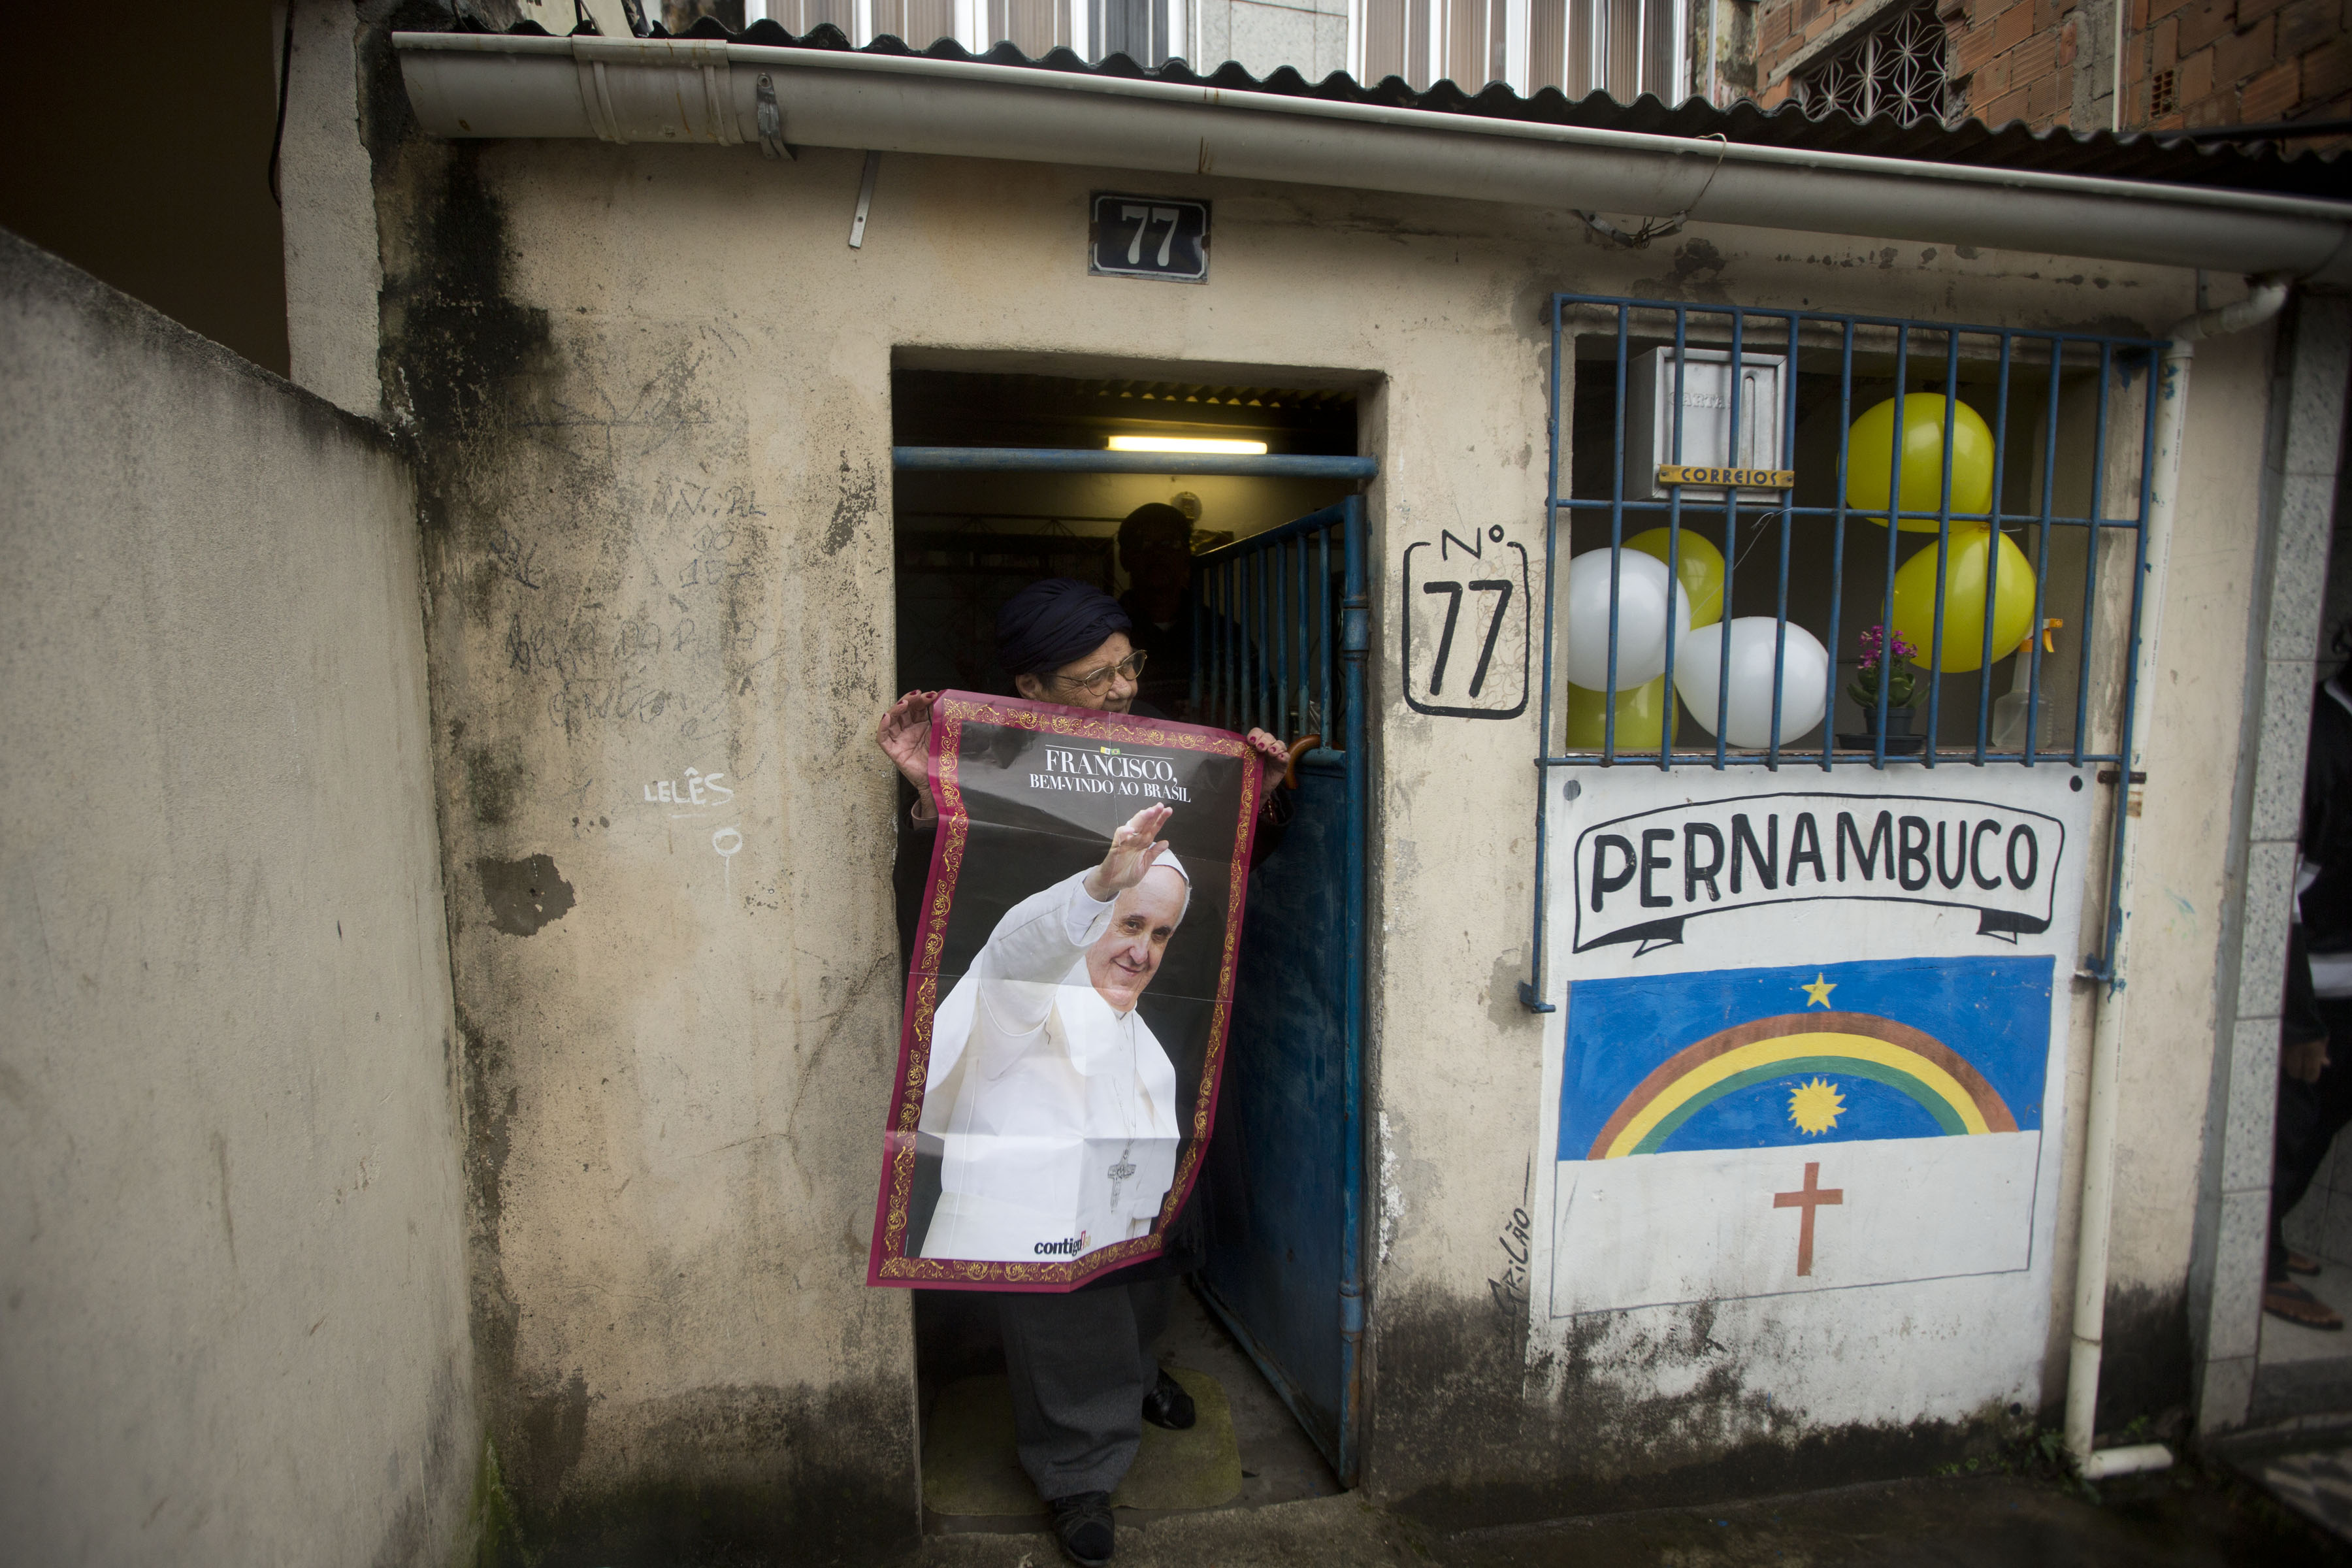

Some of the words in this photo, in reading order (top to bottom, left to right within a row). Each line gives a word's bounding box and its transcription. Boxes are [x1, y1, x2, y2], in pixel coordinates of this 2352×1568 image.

[1121, 205, 1180, 267] 77
[1668, 392, 1732, 409] CARTA
[1681, 468, 1778, 485] CORREIOS
[1423, 579, 1514, 698] 77
[644, 766, 734, 806] LELÊS
[1045, 749, 1178, 786] FRANCISCO,
[1029, 773, 1113, 795] BEM-VINDO
[1117, 781, 1139, 796] AO
[1143, 783, 1191, 803] BRASIL
[1591, 809, 2038, 913] PERNAMBUCO
